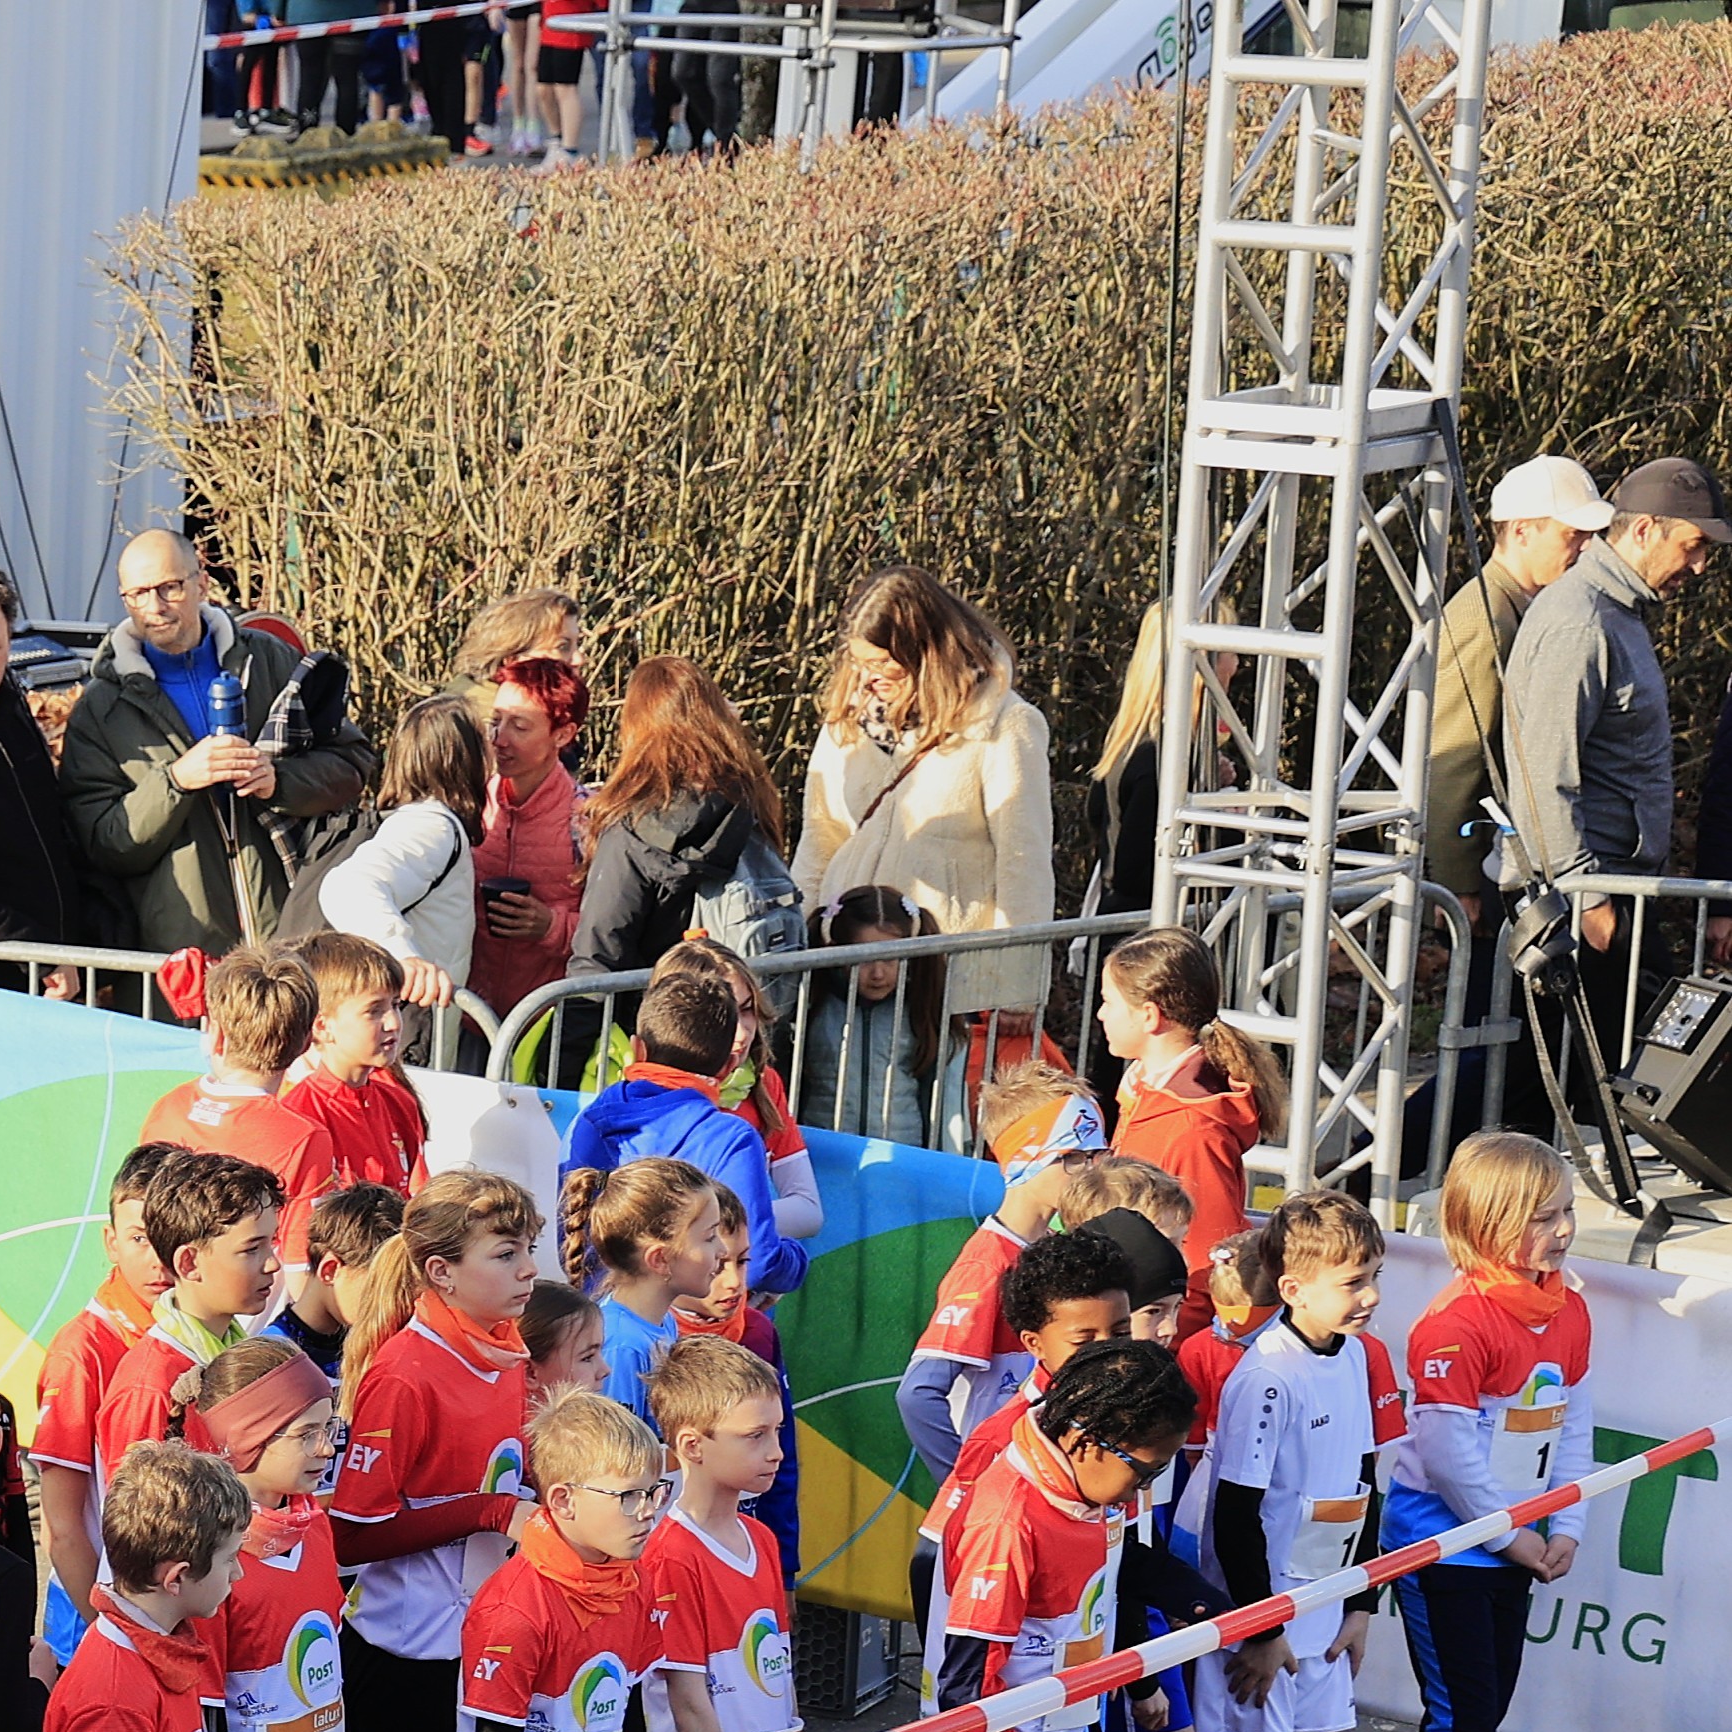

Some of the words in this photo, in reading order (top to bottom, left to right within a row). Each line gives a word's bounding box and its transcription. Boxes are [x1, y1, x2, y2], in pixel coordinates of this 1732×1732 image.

[936, 1304, 970, 1328] EY
[1424, 1358, 1453, 1380] EY
[346, 1443, 383, 1474] EY
[1536, 1441, 1551, 1480] 1
[307, 1659, 334, 1686] POST
[313, 1706, 342, 1729] lalux
[589, 1699, 616, 1716] POST
